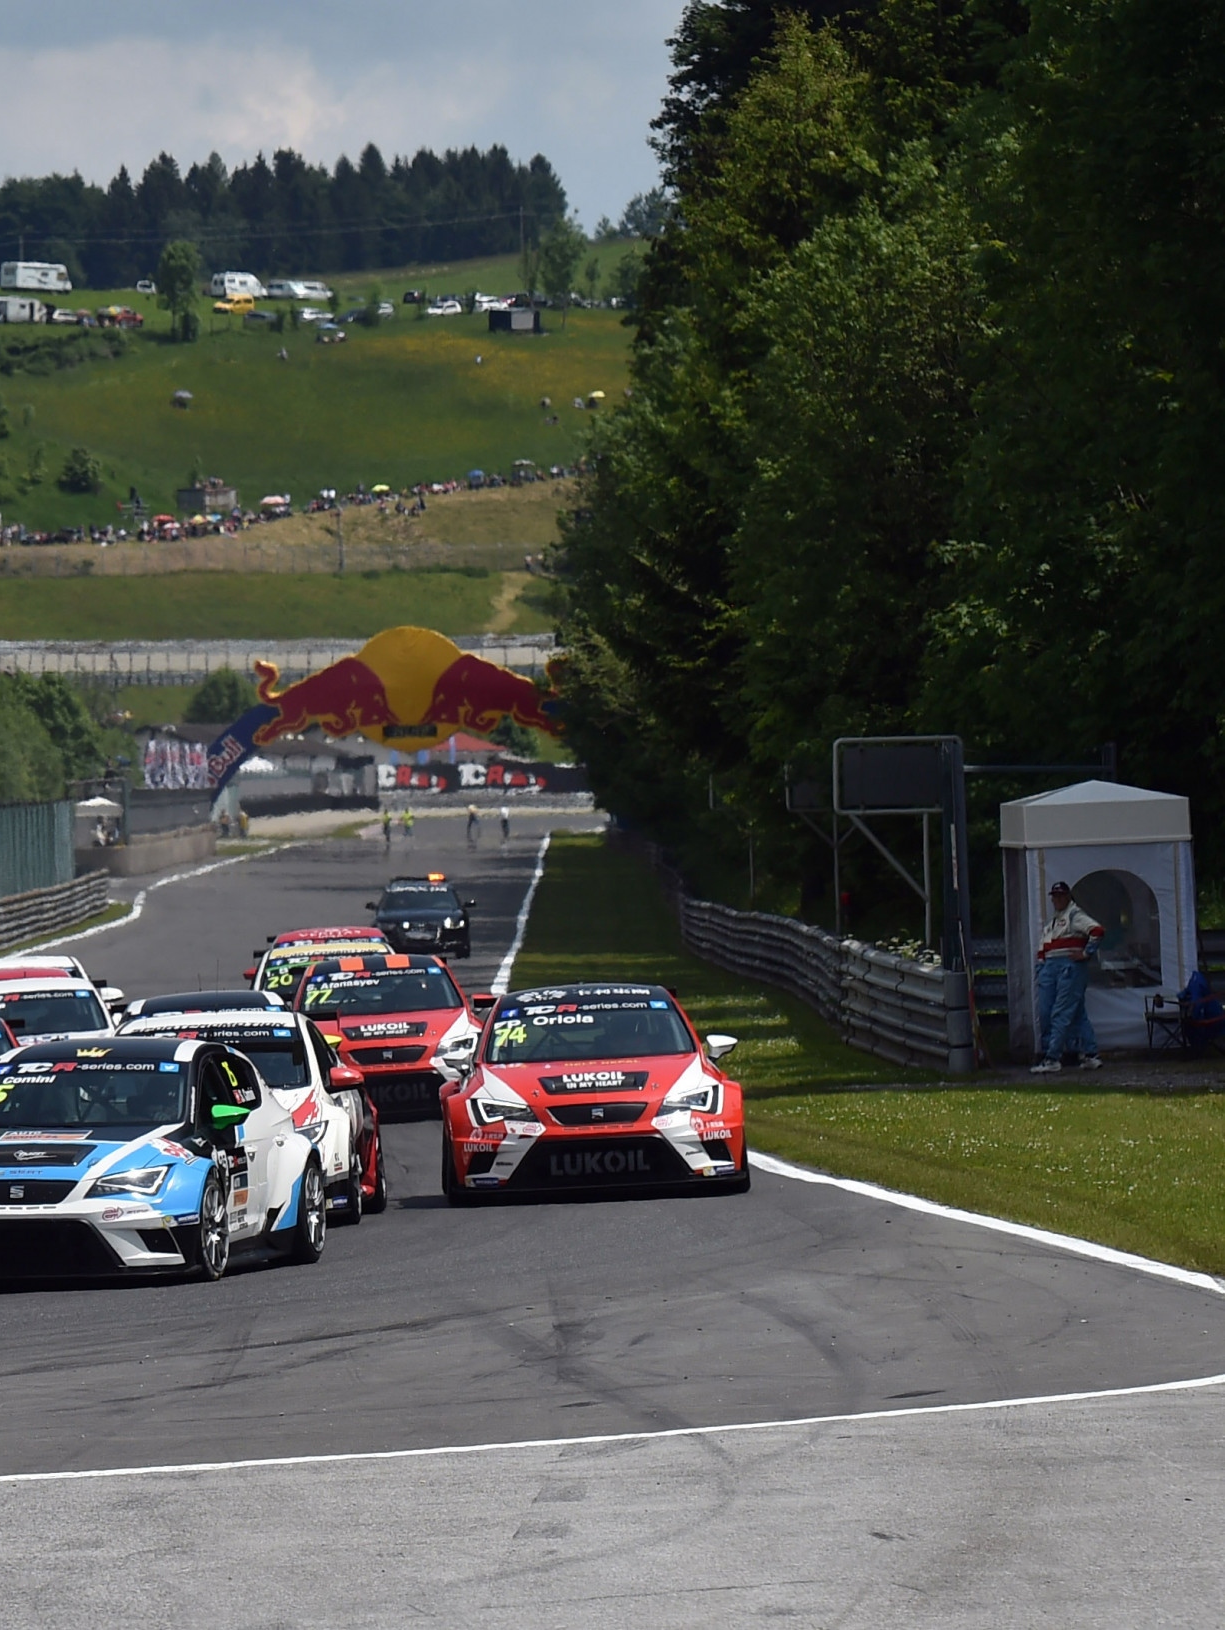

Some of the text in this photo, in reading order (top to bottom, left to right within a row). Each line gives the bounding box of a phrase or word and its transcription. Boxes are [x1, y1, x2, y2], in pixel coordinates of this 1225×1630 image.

[267, 973, 293, 990] 20
[304, 989, 333, 1005] 77
[524, 1002, 647, 1016] TCR-series.com
[532, 1013, 594, 1026] Oriola
[360, 1022, 410, 1032] LUKOIL
[494, 1026, 527, 1047] 74
[17, 1062, 155, 1075] TCR-series.com
[3, 1074, 57, 1084] Comini
[562, 1071, 626, 1082] LUKOIL
[703, 1129, 732, 1141] LUKOIL
[463, 1143, 494, 1152] LUKOIL
[550, 1149, 651, 1177] LUKOIL
